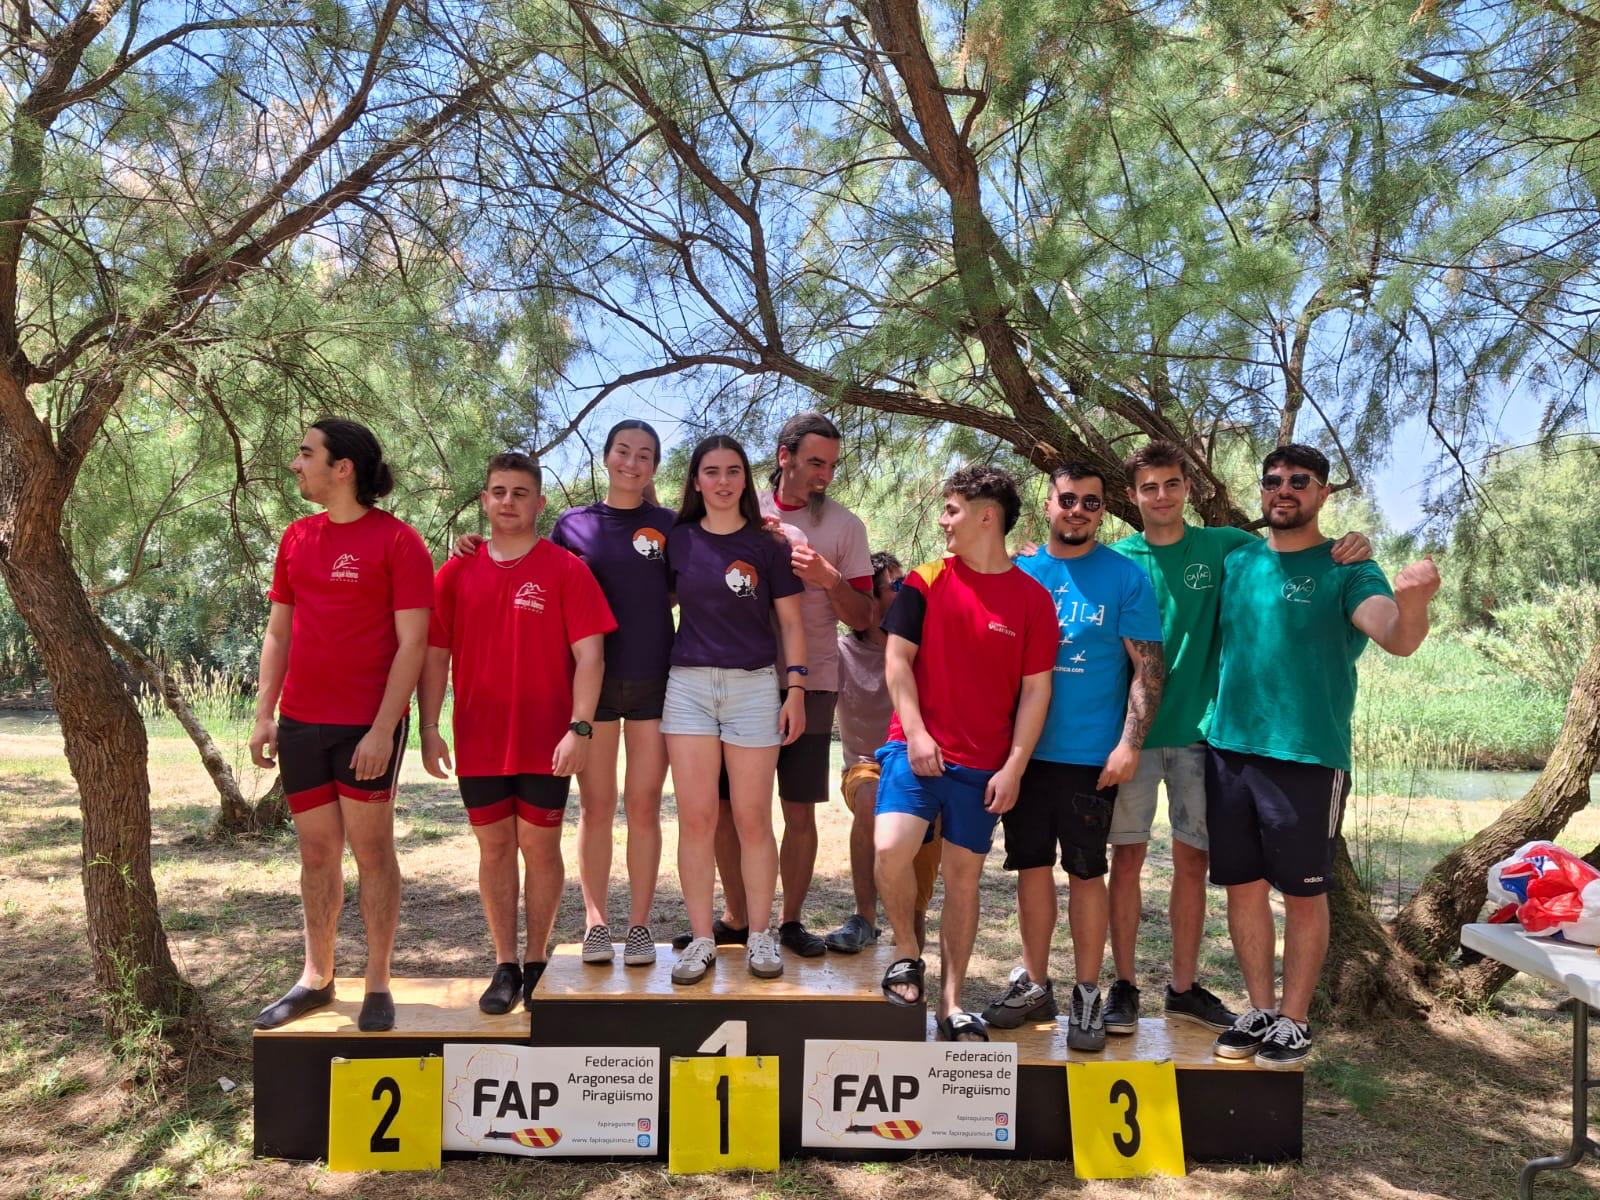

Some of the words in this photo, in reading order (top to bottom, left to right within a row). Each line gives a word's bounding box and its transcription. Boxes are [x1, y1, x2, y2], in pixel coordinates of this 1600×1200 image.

[585, 1055, 654, 1067] Federación
[945, 1050, 1012, 1063] Federación
[567, 1073, 635, 1087] Aragonesa
[638, 1073, 654, 1084] de
[928, 1067, 993, 1081] Aragonesa
[996, 1067, 1012, 1079] de
[582, 1089, 653, 1104] Piragüismo
[833, 1074, 920, 1113] FAP
[942, 1084, 1011, 1098] Piragüismo
[473, 1078, 559, 1120] FAP
[370, 1076, 401, 1153] 2
[716, 1075, 729, 1155] 1
[1109, 1079, 1141, 1158] 3
